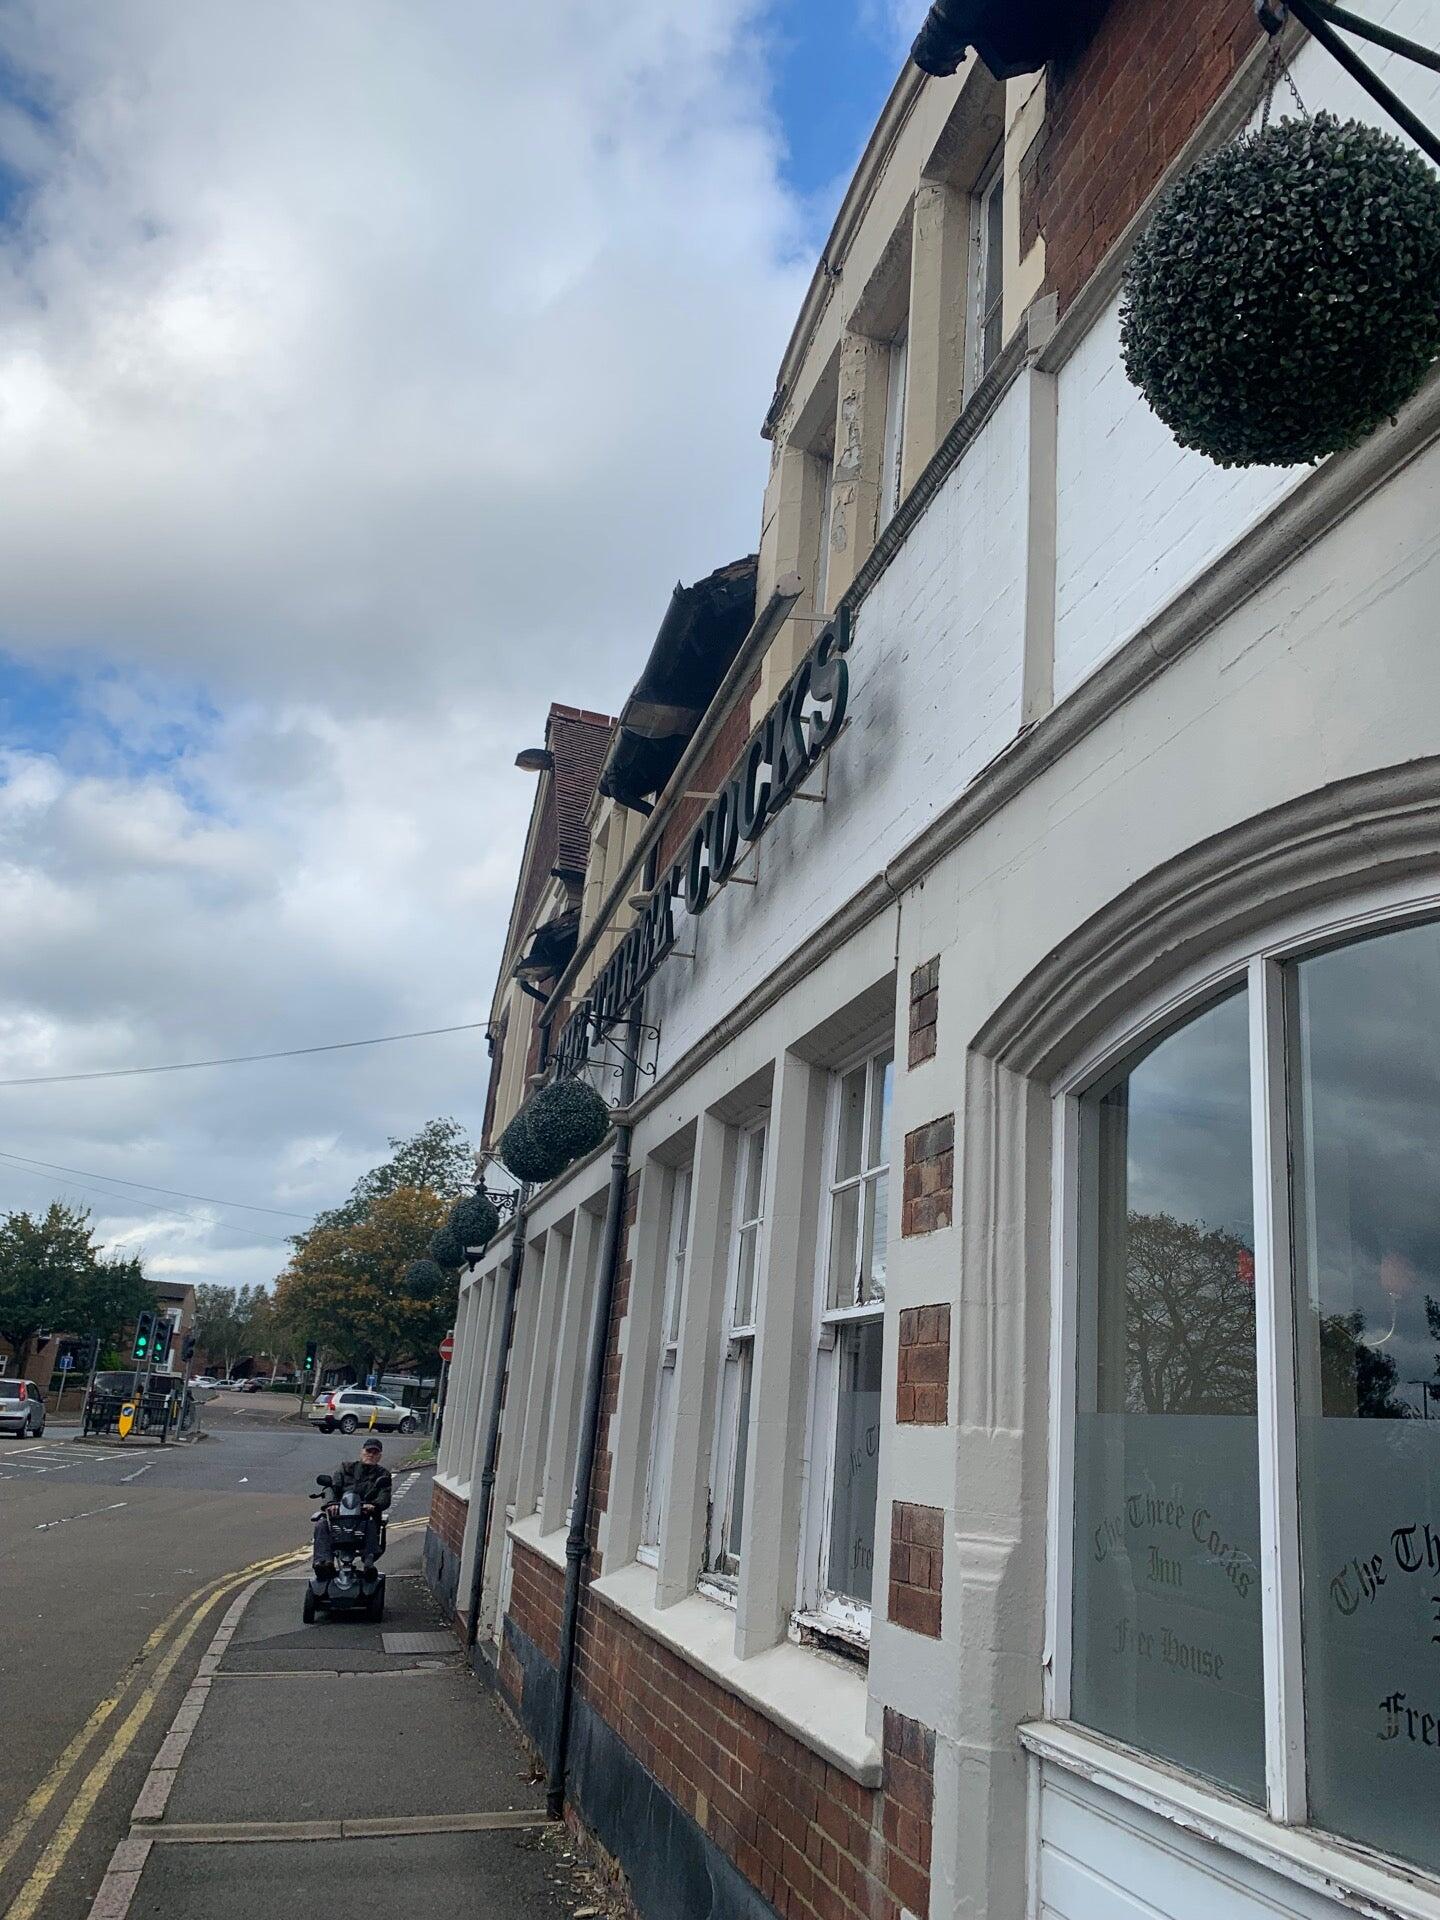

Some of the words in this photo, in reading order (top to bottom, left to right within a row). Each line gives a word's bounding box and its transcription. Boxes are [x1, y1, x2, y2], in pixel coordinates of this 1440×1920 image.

[591, 866, 681, 1047] THREE
[686, 606, 850, 915] COCKS
[1127, 1494, 1186, 1531] Three
[1146, 1545, 1184, 1588] Inn
[1330, 1555, 1387, 1616] The
[1160, 1626, 1226, 1681] House
[1376, 1690, 1440, 1748] Fre
